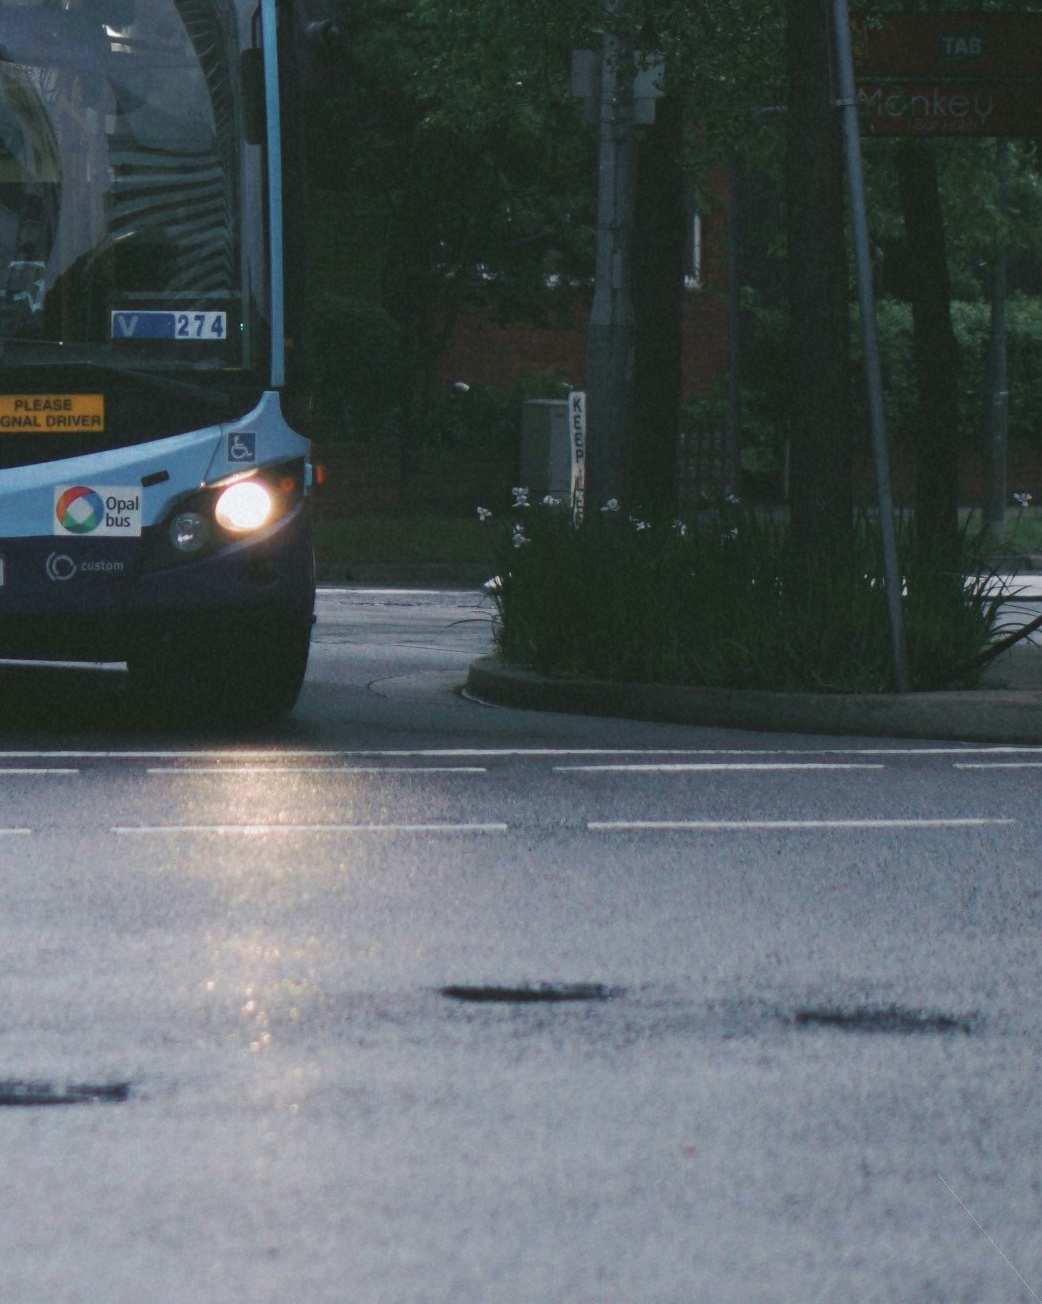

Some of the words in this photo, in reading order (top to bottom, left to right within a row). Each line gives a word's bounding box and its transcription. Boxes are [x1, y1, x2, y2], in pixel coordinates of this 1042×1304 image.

[942, 37, 983, 55] TAB
[858, 87, 994, 125] Monkey
[117, 315, 139, 337] V
[177, 314, 224, 338] 274
[14, 399, 72, 412] PLEASE
[46, 414, 101, 427] DRIVER
[573, 397, 584, 463] KEEP
[106, 496, 139, 514] Opal
[106, 512, 131, 528] bus
[81, 561, 124, 571] custom
